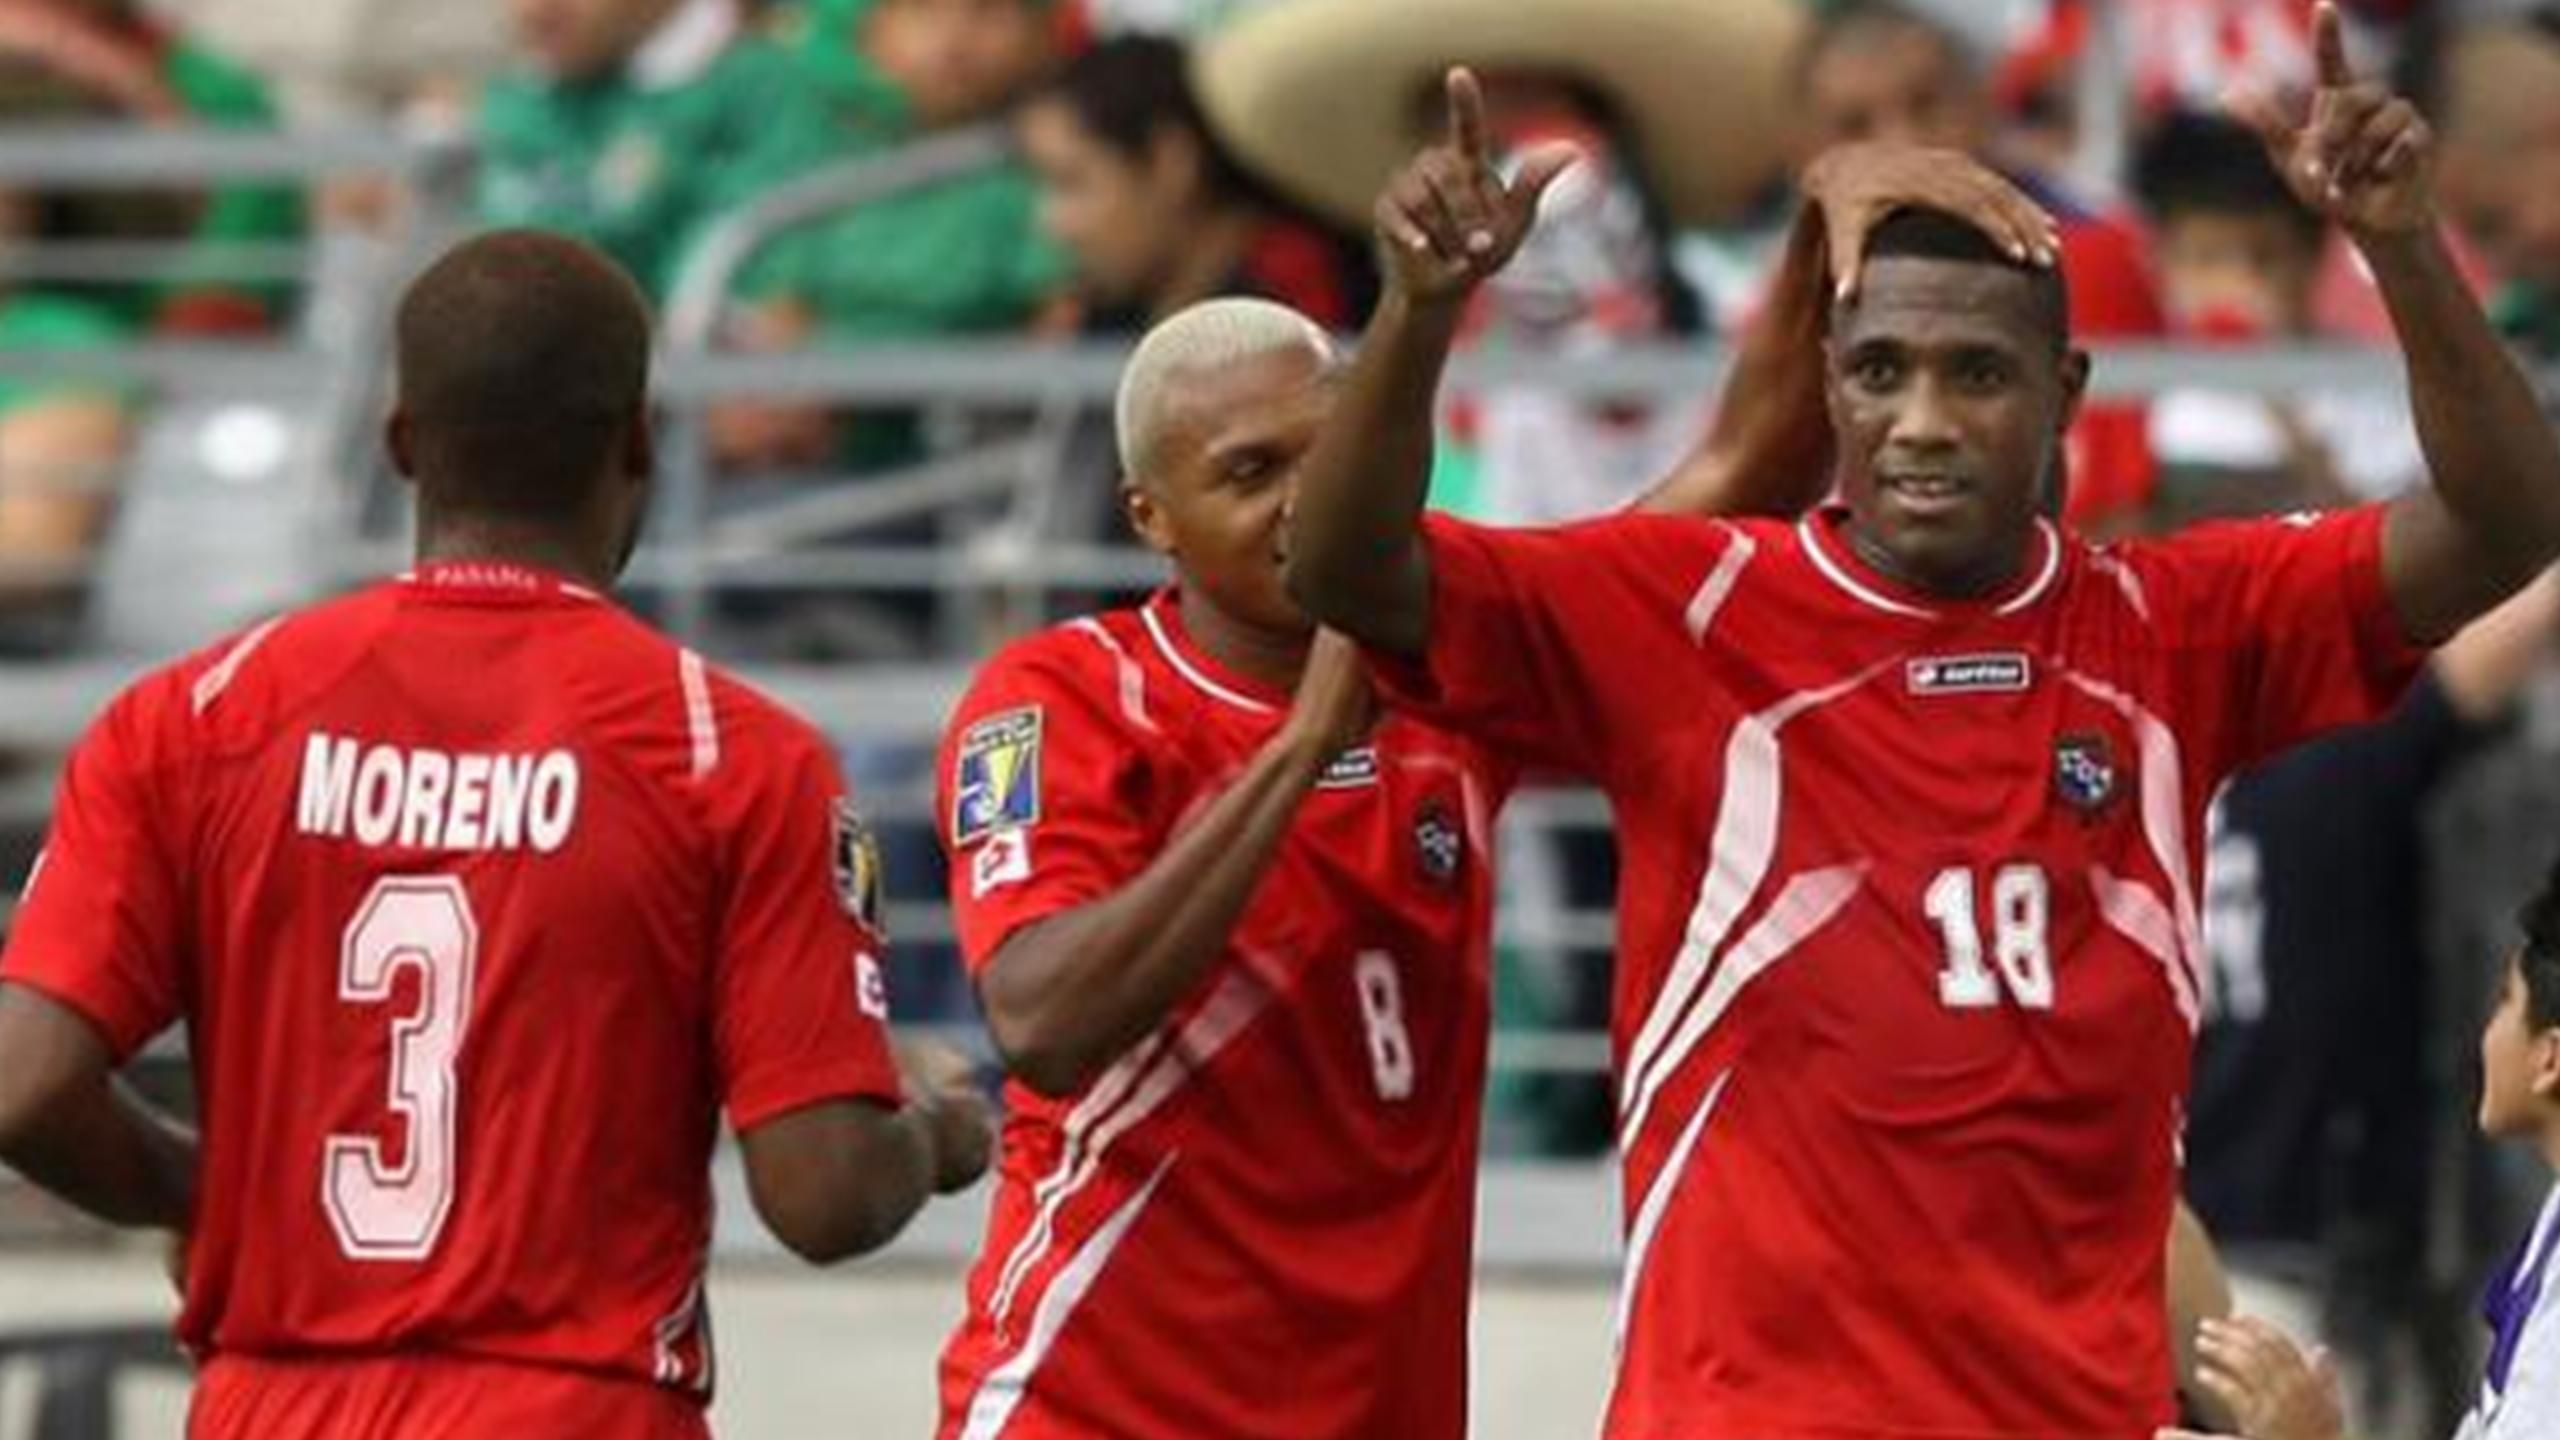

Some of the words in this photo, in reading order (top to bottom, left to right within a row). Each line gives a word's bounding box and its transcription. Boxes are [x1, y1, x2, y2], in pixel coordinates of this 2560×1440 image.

[298, 734, 580, 852] MORENO
[1923, 864, 2054, 1009] 18
[323, 875, 478, 1260] 3
[1355, 949, 1414, 1101] 8
